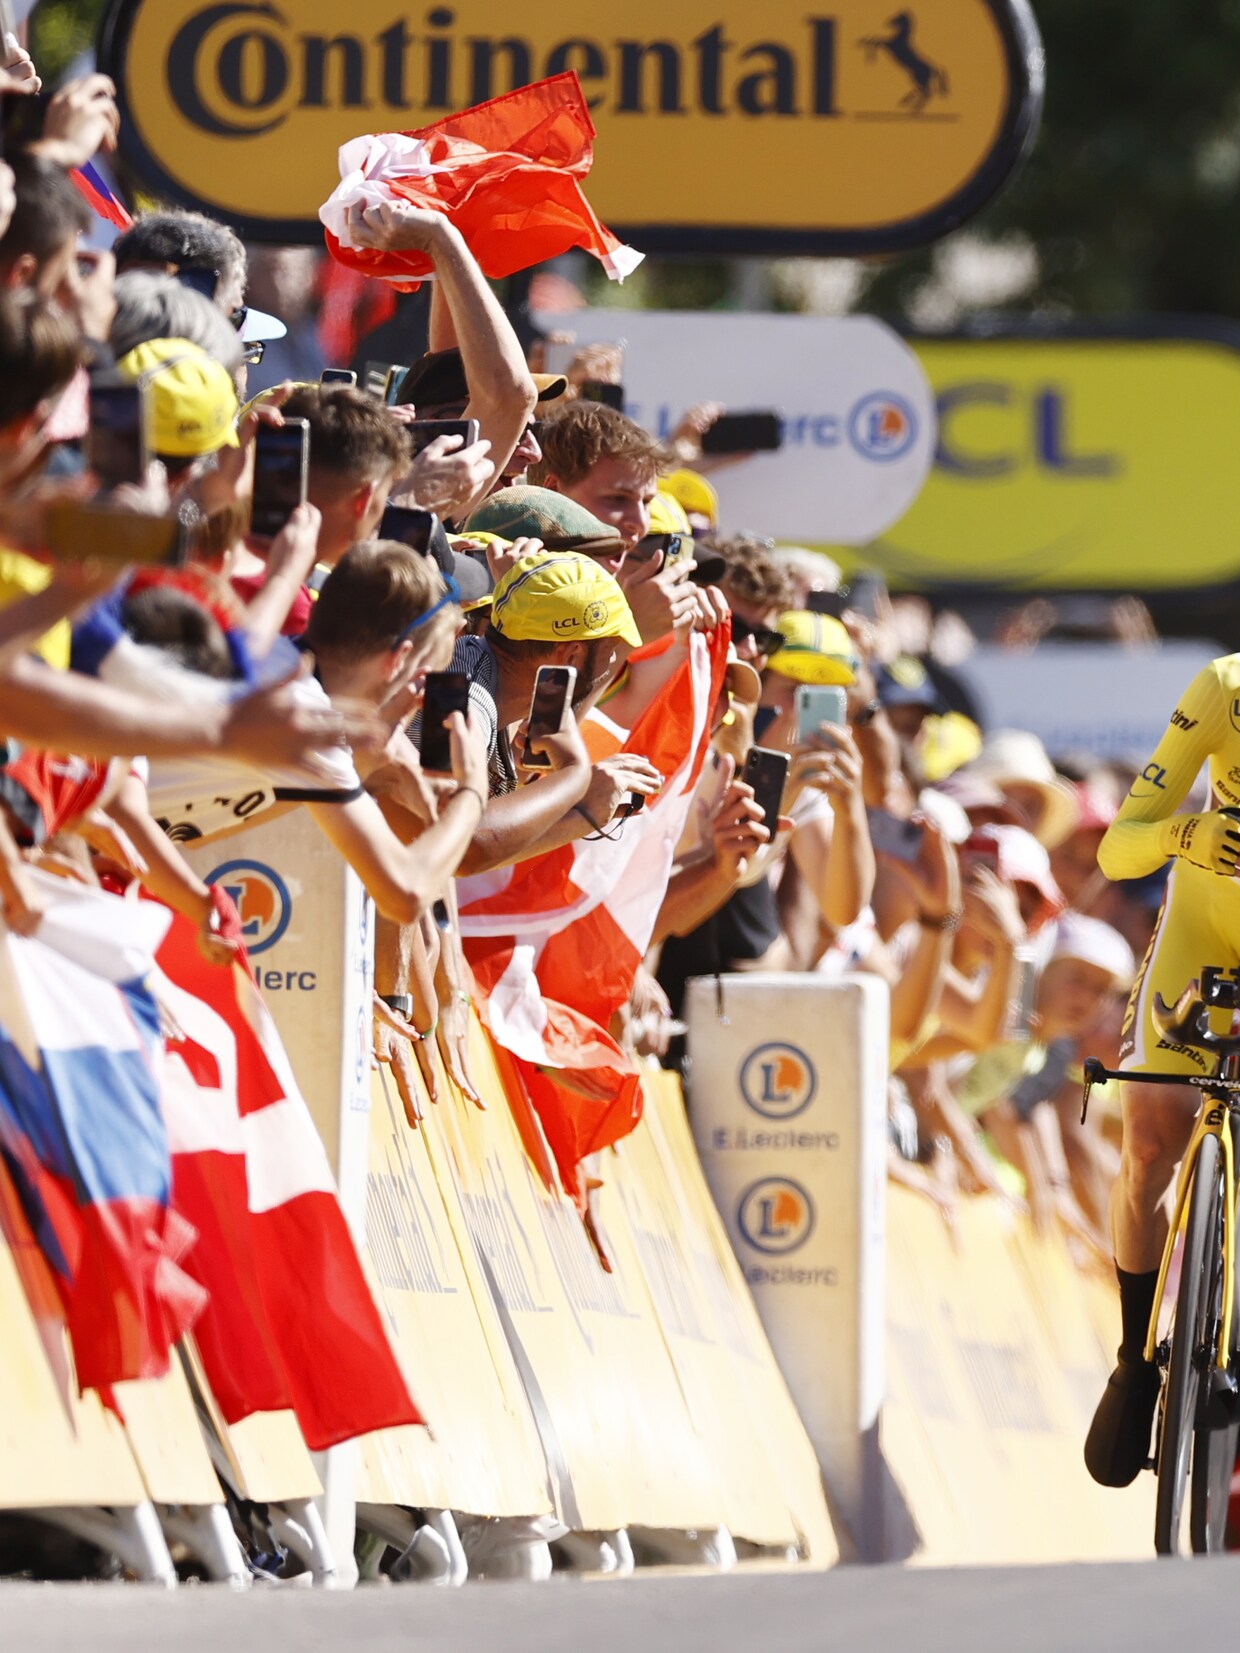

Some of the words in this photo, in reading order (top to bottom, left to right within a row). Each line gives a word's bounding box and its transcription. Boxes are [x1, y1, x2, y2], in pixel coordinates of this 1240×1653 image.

[166, 2, 846, 136] Continental
[933, 380, 1120, 483] CL
[554, 617, 581, 629] LCL
[1169, 708, 1199, 731] tini
[1141, 762, 1167, 790] CL
